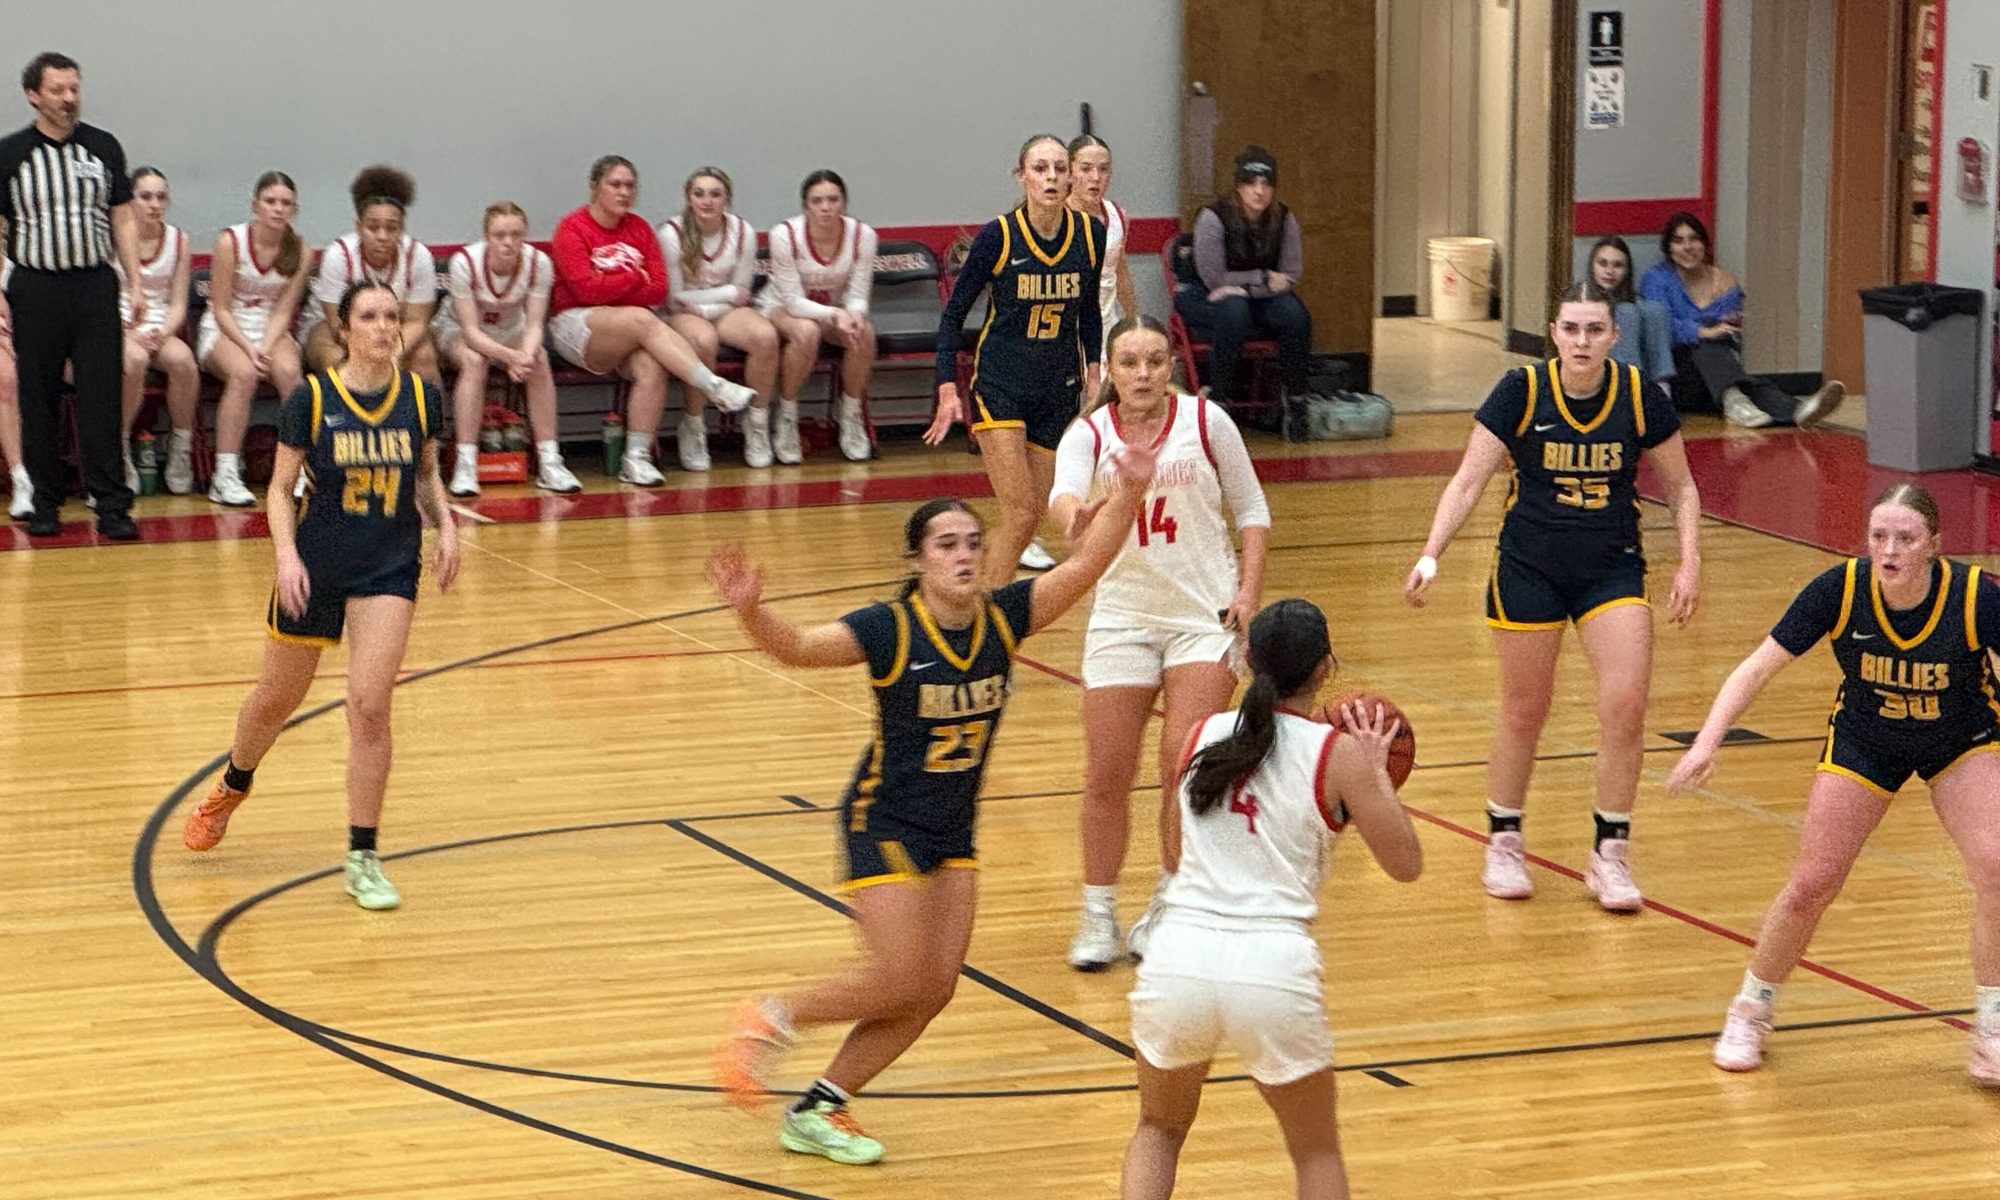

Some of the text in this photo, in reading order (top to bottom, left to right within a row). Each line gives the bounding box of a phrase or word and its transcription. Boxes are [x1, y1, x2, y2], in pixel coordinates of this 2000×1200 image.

[1017, 272, 1080, 300] BILLIES
[1027, 303, 1066, 339] 15
[333, 428, 413, 466] BILLIES
[1543, 441, 1623, 472] BILLIES
[342, 467, 401, 517] 24
[1553, 477, 1611, 509] 35
[1136, 496, 1178, 548] 14
[1861, 651, 1950, 691] BILLIES
[1873, 688, 1942, 720] 30
[923, 720, 991, 773] 23
[1230, 772, 1259, 834] 4
